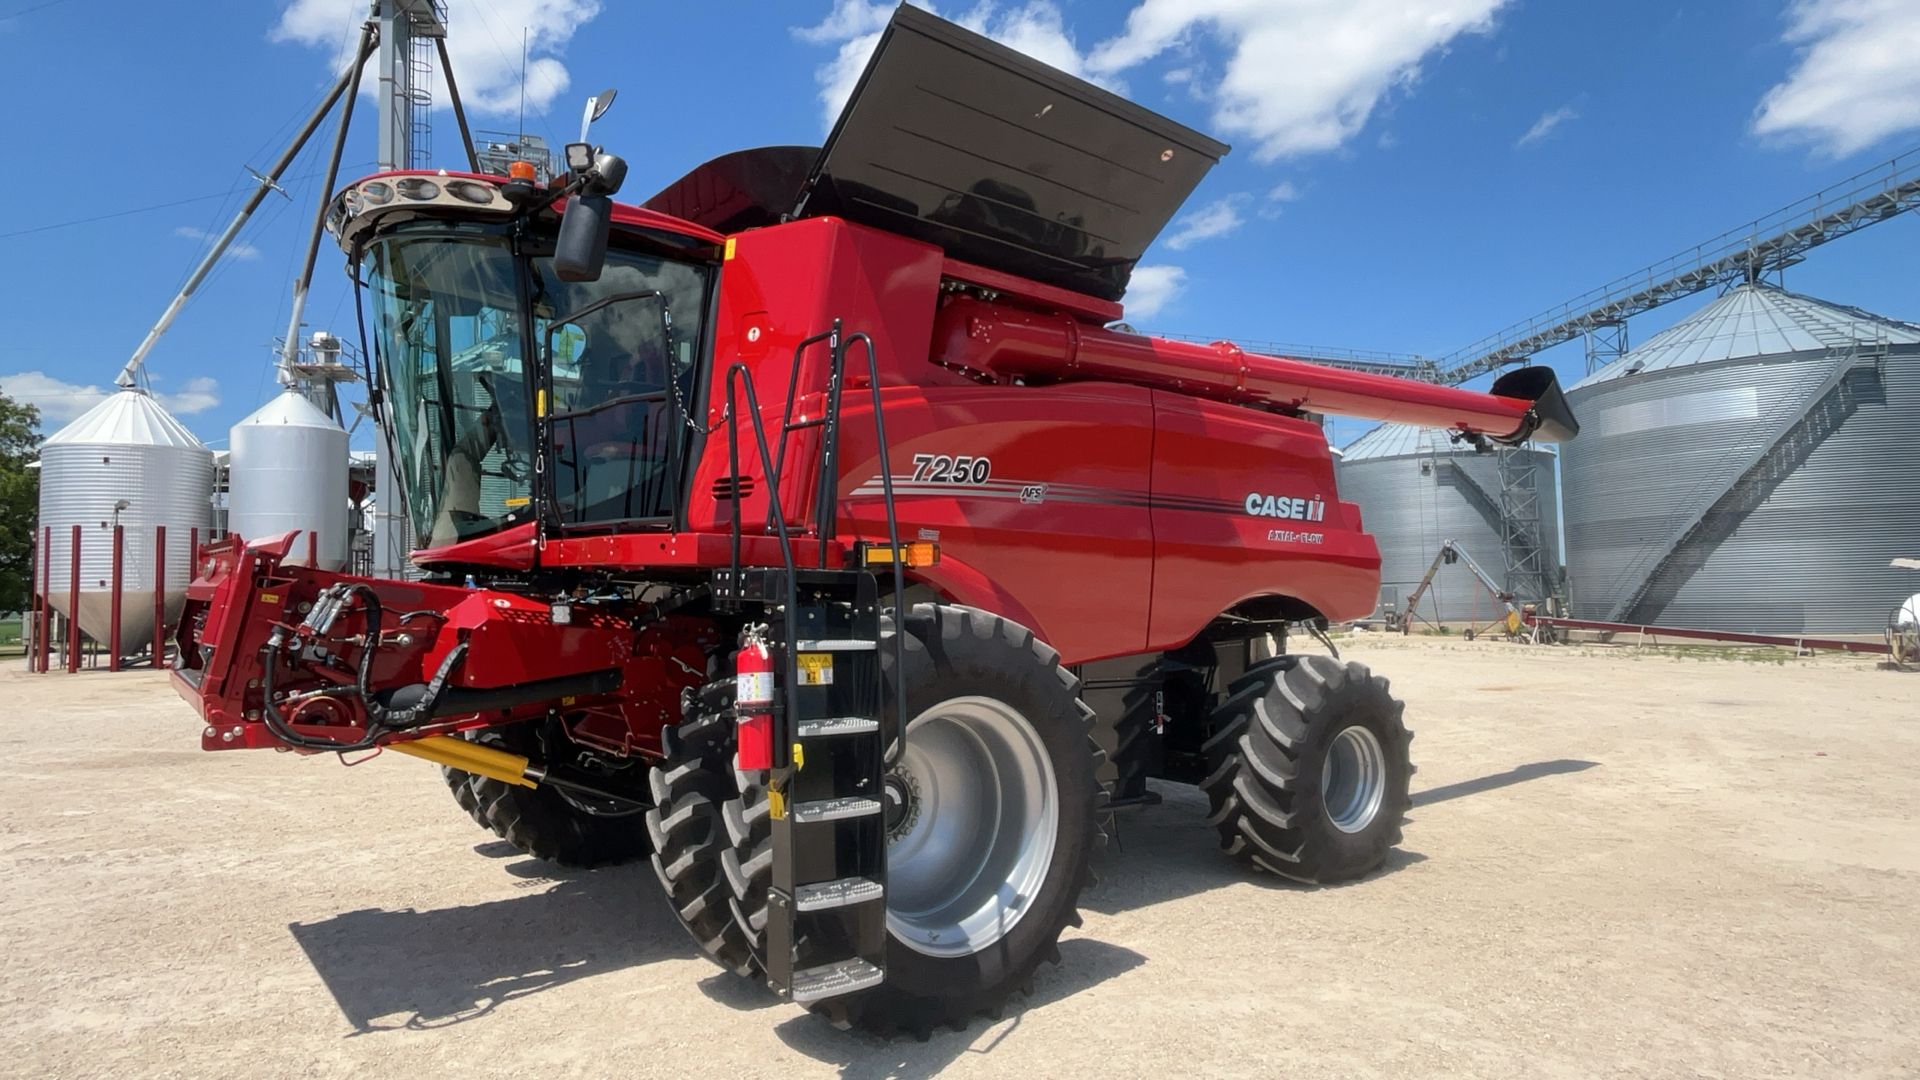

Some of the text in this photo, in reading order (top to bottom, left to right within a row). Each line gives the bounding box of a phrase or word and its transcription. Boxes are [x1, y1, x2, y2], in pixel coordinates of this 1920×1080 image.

[912, 453, 991, 485] 7250
[1021, 487, 1042, 498] AFS
[1245, 493, 1305, 519] CASE
[1268, 530, 1323, 544] AXIAL-FLOW
